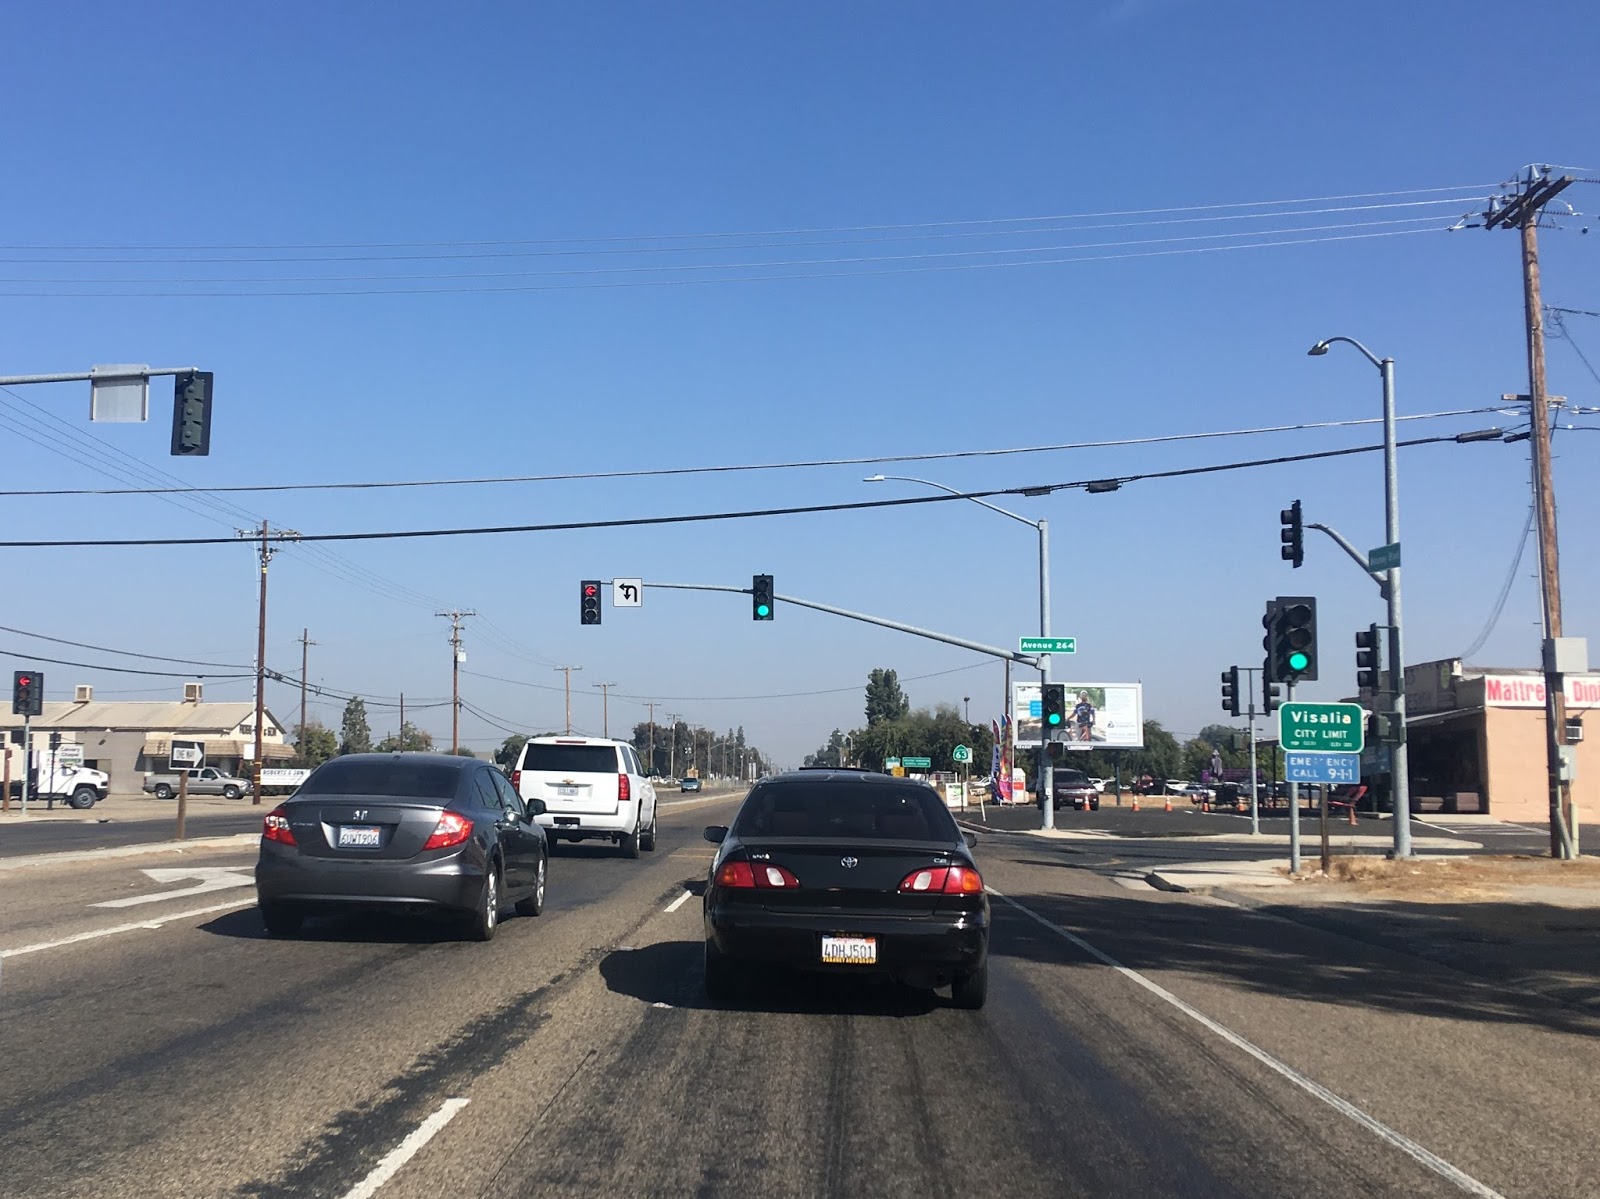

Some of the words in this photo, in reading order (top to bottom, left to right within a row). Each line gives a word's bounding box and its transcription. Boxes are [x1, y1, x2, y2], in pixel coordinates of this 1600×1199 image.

[1291, 711, 1352, 725] Visalia
[1294, 729, 1317, 738] CITY
[1322, 730, 1348, 739] LIMIT
[1290, 757, 1355, 767] EMEENCY
[1293, 769, 1319, 778] CALL
[1328, 769, 1353, 780] 9-1-1
[824, 944, 873, 958] 4DHJ501
